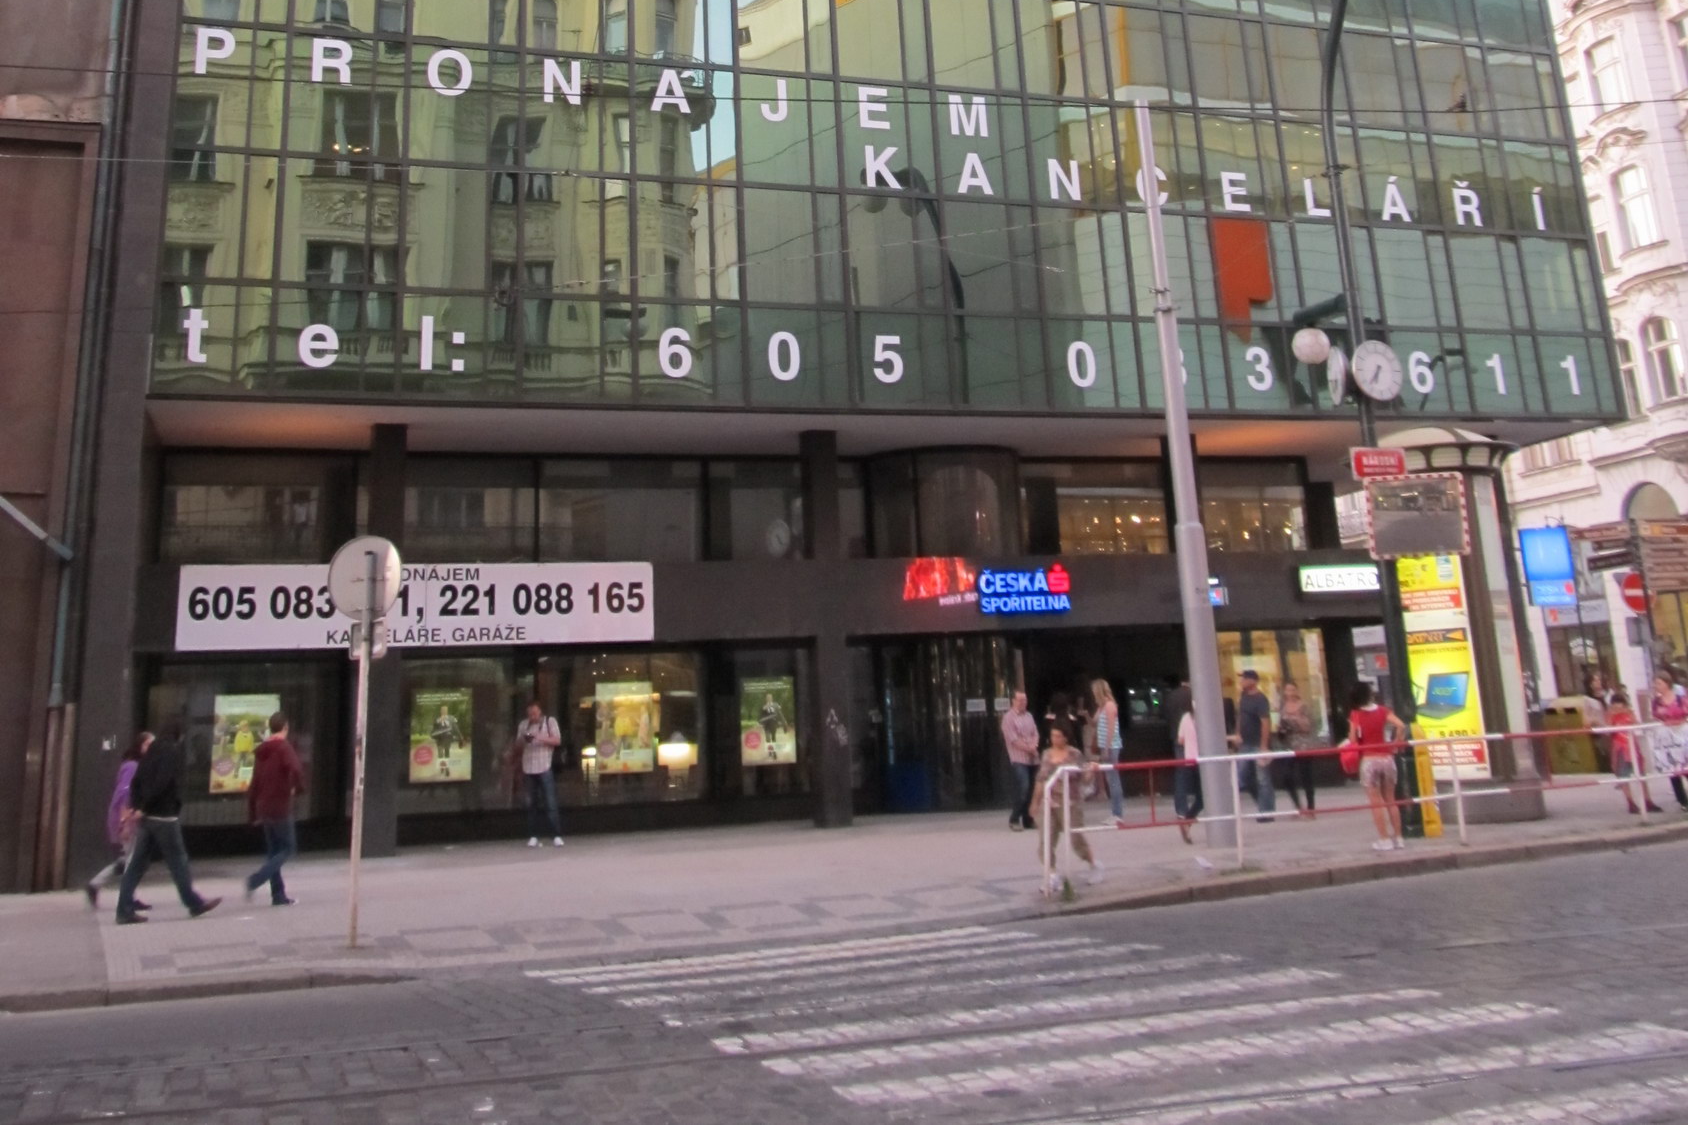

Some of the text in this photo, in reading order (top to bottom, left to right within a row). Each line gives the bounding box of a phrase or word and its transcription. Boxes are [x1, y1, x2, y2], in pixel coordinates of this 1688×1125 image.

[183, 308, 1582, 397] tel: 605 03 611
[401, 566, 481, 581] ONÁJEM
[978, 568, 1048, 594] ČESKÁ
[188, 581, 645, 624] 605 083 1, 221 088 165
[981, 594, 1071, 613] SPOŘITELNA
[326, 625, 527, 645] KALÁŘE, GARÁŽE
